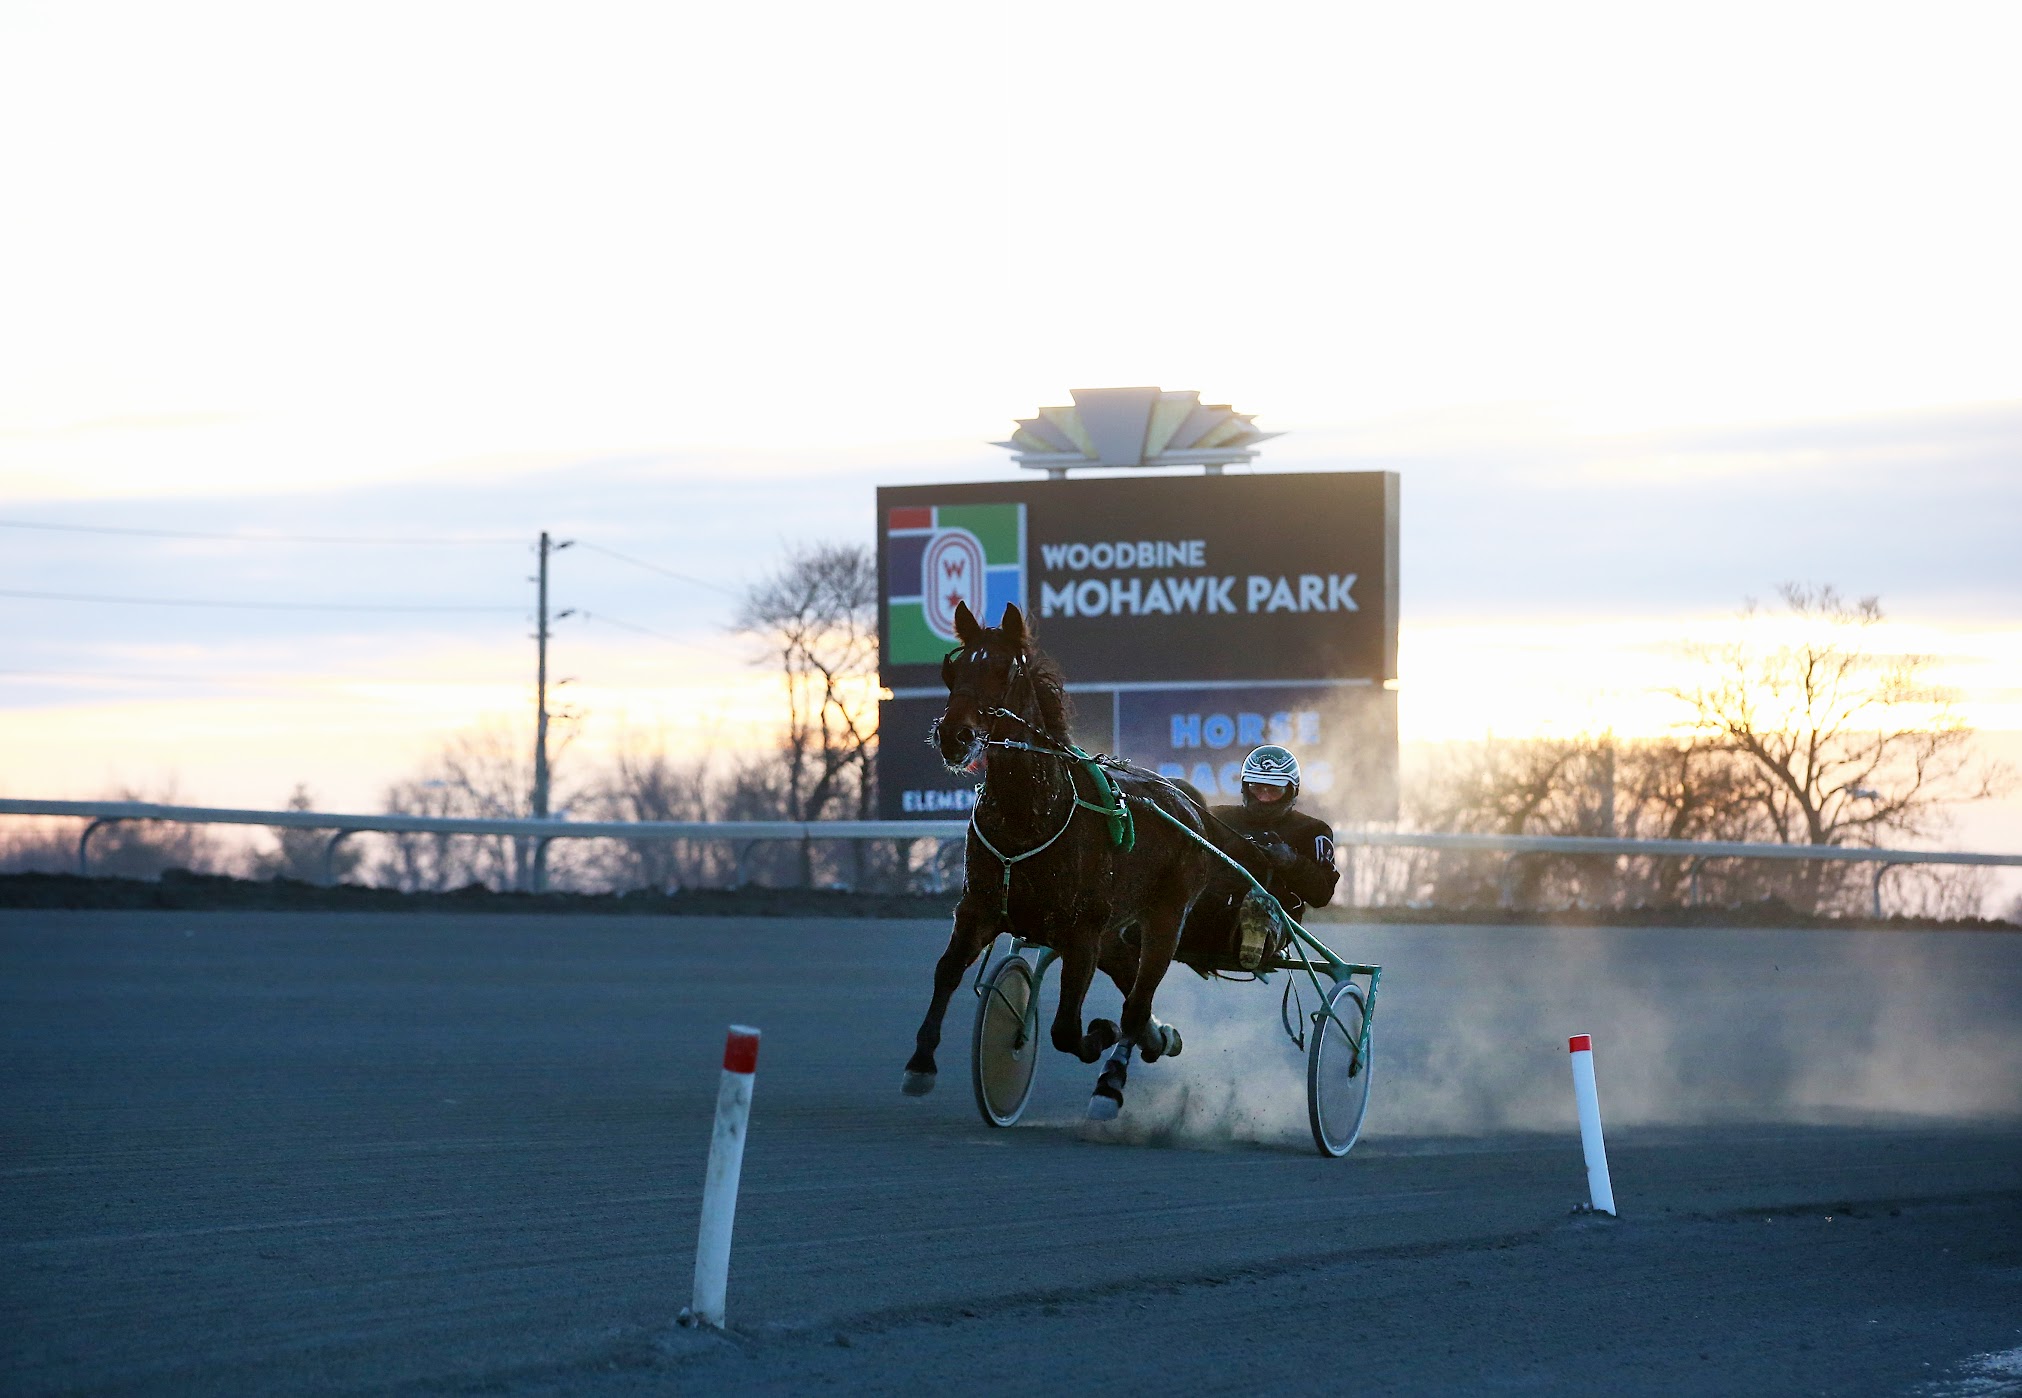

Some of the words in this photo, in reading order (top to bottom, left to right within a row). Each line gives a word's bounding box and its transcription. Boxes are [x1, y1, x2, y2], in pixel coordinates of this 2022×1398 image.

[943, 558, 966, 578] W
[1041, 540, 1206, 571] WOODBINE
[1041, 575, 1238, 617] MOHAWK
[1246, 573, 1360, 613] PARK
[1171, 711, 1321, 748] HORSE
